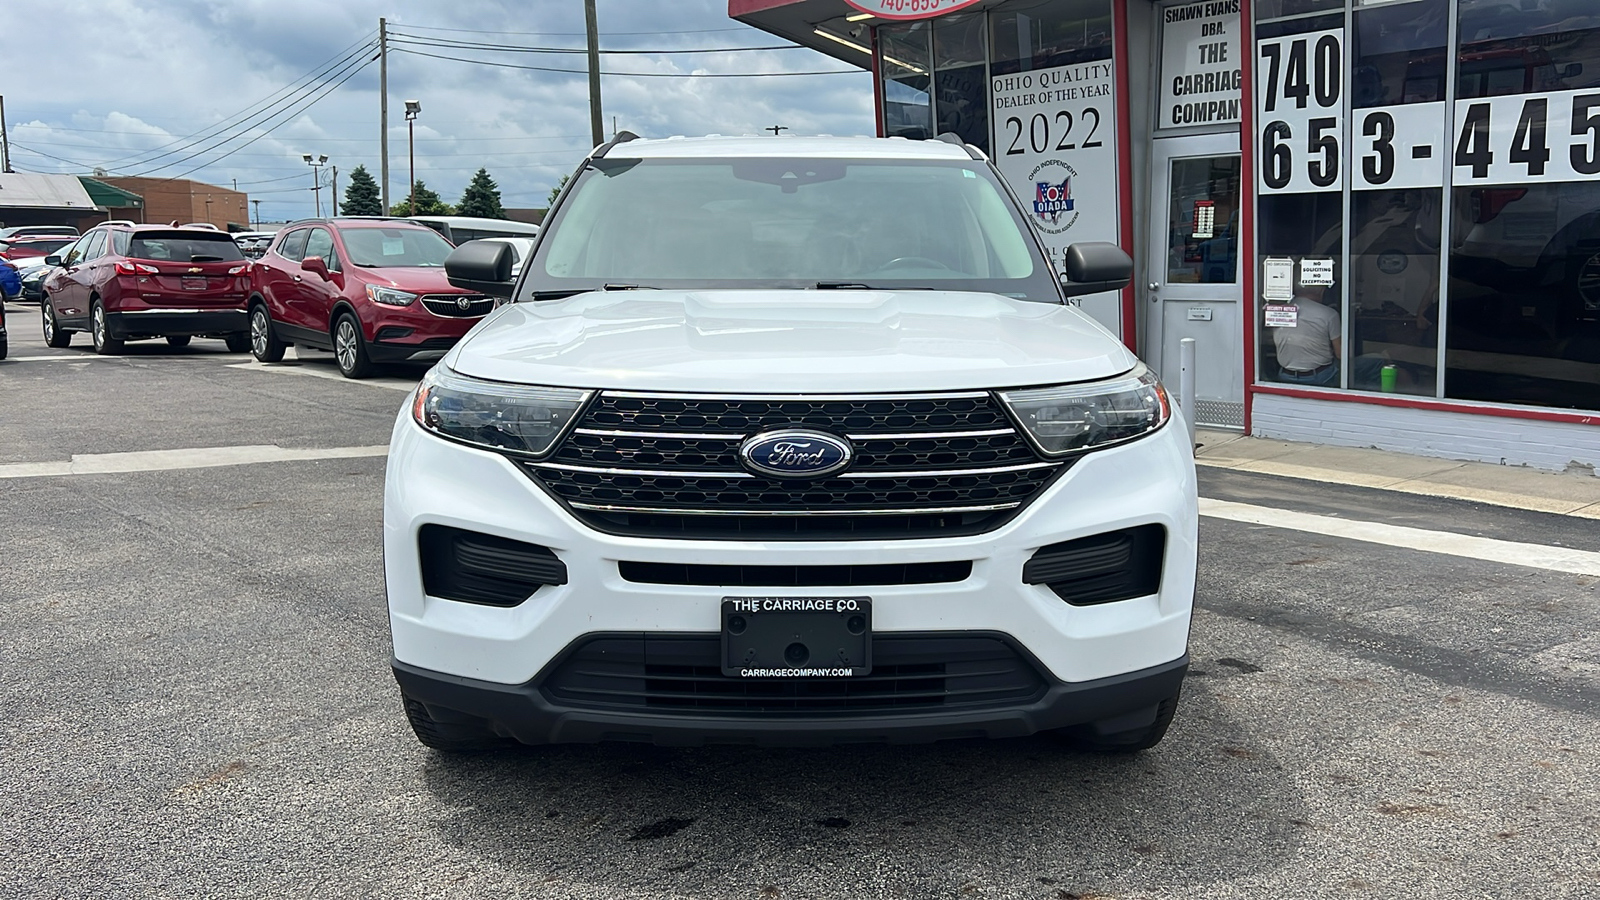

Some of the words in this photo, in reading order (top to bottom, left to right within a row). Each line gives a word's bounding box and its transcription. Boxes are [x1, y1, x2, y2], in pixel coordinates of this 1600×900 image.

[1165, 4, 1203, 23] SHAWN
[1201, 21, 1226, 37] DBA.
[1198, 41, 1228, 65] THE
[993, 75, 1033, 93] OHIO
[1039, 63, 1112, 88] QUALITY
[1261, 34, 1340, 112] 740
[996, 93, 1036, 109] DEALER
[1038, 91, 1053, 104] OF
[1055, 88, 1077, 101] THE
[1080, 83, 1110, 98] YEAR
[1172, 99, 1242, 125] COMPAN
[1005, 107, 1103, 156] 2022
[1028, 165, 1041, 181] OHIO
[1040, 159, 1078, 177] INDEPENDENT
[1038, 200, 1068, 212] OIADA
[768, 441, 825, 466] Ford
[732, 599, 760, 612] THE
[763, 599, 834, 611] CARRIAGE
[836, 599, 860, 612] CO.
[741, 668, 853, 677] CARRIAGECOMPANY.COM
